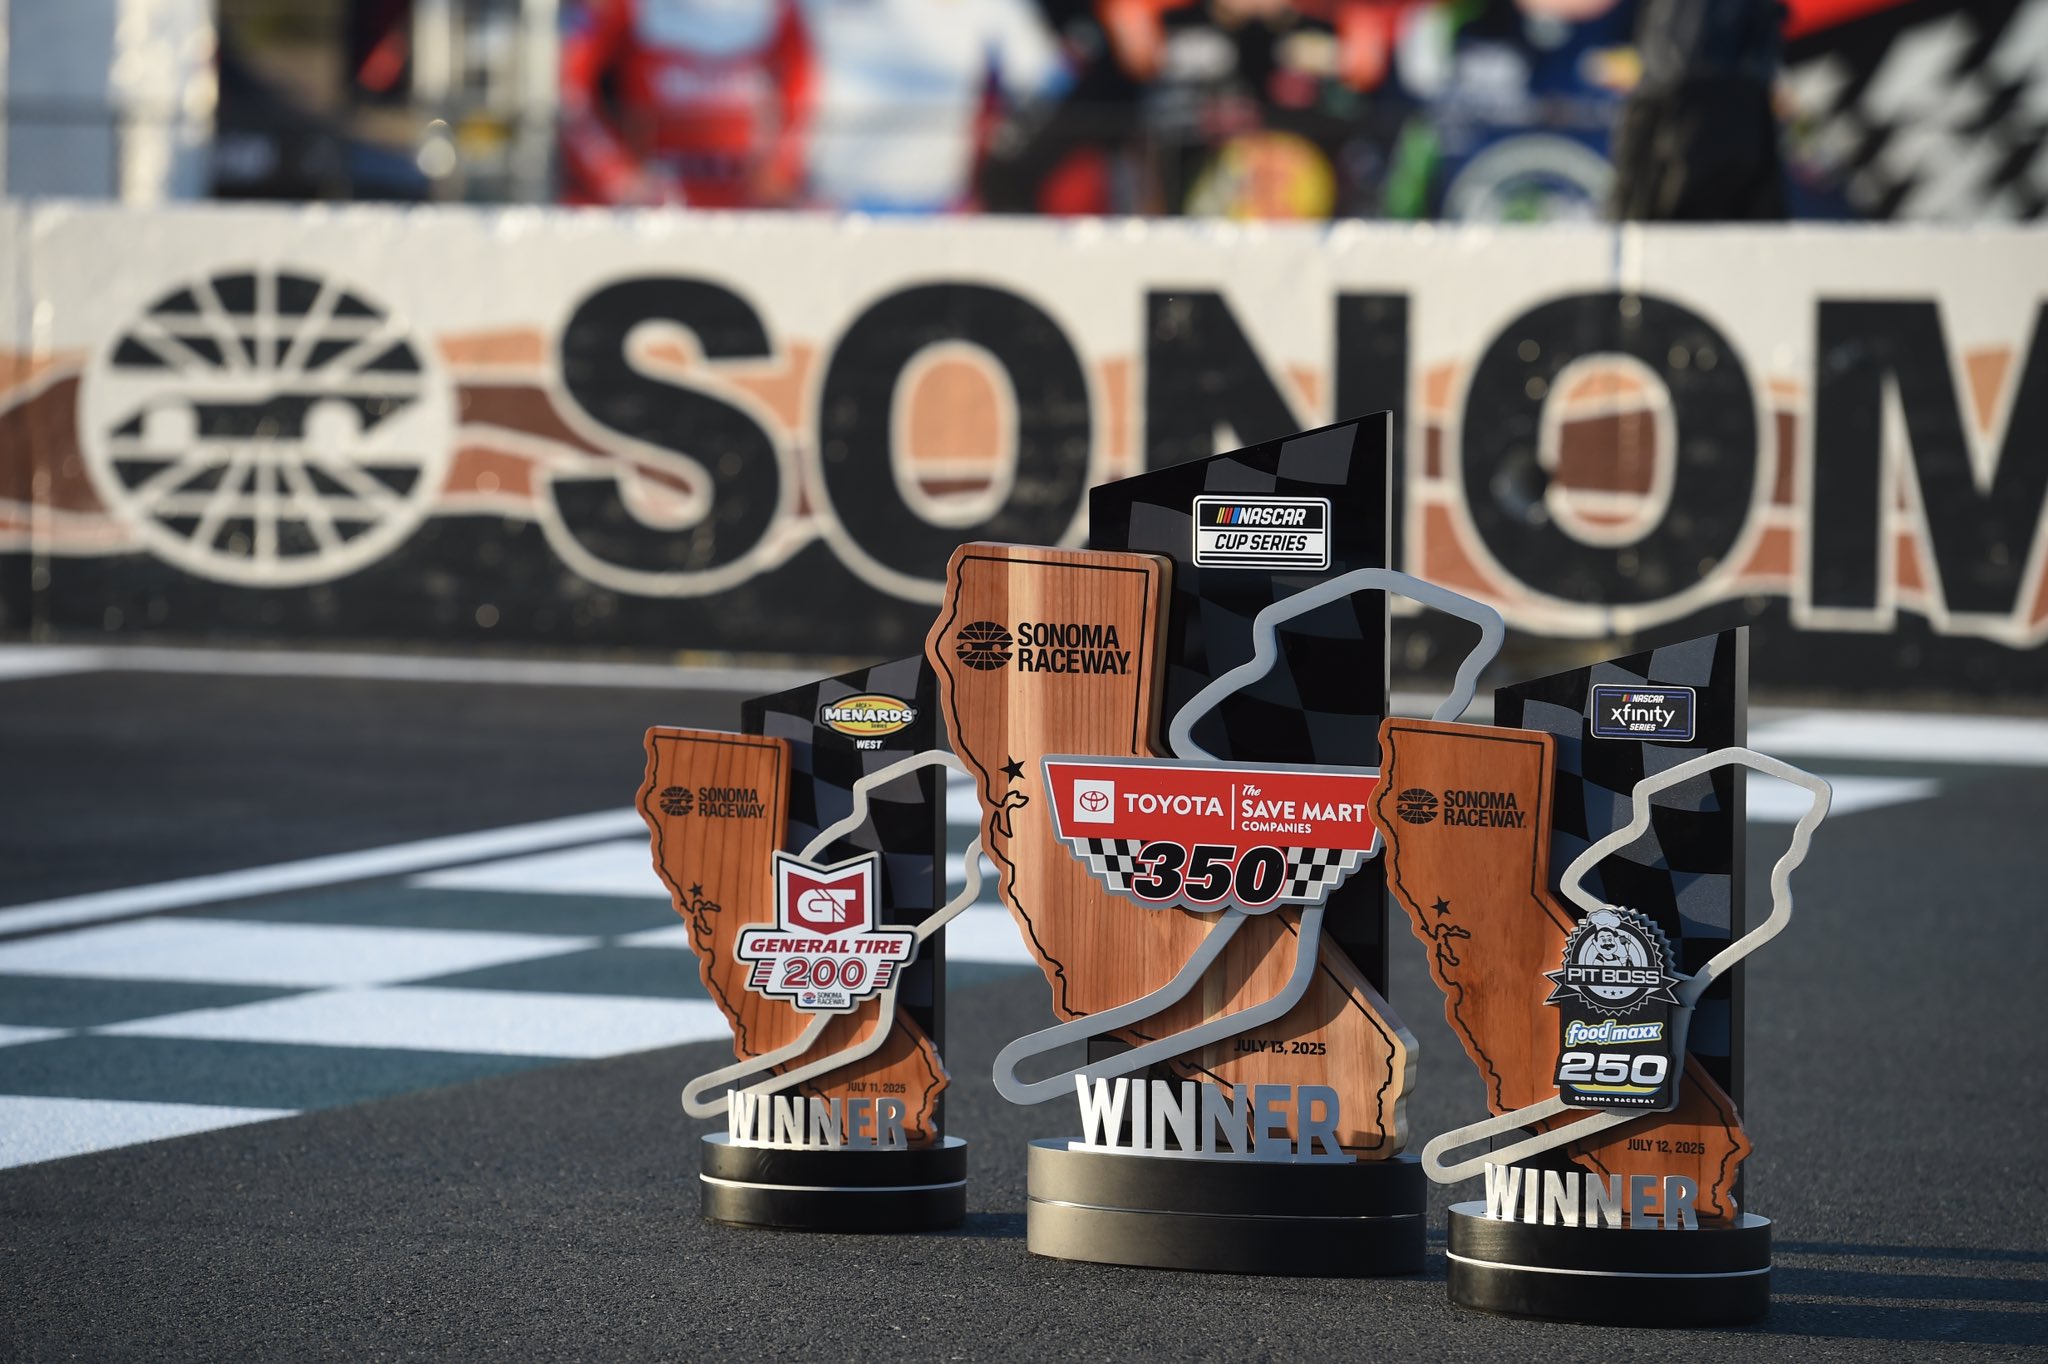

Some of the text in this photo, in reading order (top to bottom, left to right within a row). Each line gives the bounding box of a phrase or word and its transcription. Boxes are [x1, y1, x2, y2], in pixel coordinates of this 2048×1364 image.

[1237, 507, 1307, 526] NASCAR
[1215, 533, 1308, 551] CUP SERIES
[1017, 622, 1120, 649] SONOMA
[1018, 649, 1131, 674] RACEWAY
[1632, 694, 1664, 704] NASCAR
[824, 708, 913, 722] MENARDS
[1610, 703, 1676, 728] xfinity
[1629, 723, 1657, 731] SERIES
[856, 740, 882, 750] WEST
[698, 787, 759, 803] SONOMA
[1242, 784, 1261, 797] The
[1444, 789, 1518, 809] SONOMA
[698, 803, 765, 819] RACEWAY
[1123, 793, 1224, 817] TOYOTA
[1241, 799, 1366, 823] SAVE MART
[1241, 821, 1312, 834] COMPANIES
[1444, 808, 1525, 828] RACEWAY
[1132, 841, 1288, 905] 350
[797, 888, 857, 923] GT
[750, 938, 903, 954] GENERAL TIRE
[780, 957, 867, 990] 200
[1567, 967, 1660, 985] PIT BOSS
[1234, 1040, 1327, 1055] JULY 13, 2025
[1558, 1051, 1669, 1085] 250
[847, 1082, 867, 1092] JULY
[882, 1082, 906, 1094] 2025
[727, 1089, 908, 1150] WINNER
[1075, 1074, 1343, 1160] WINNER
[1627, 1138, 1705, 1155] JULY 12, 2025
[1485, 1162, 1698, 1230] WINNER
